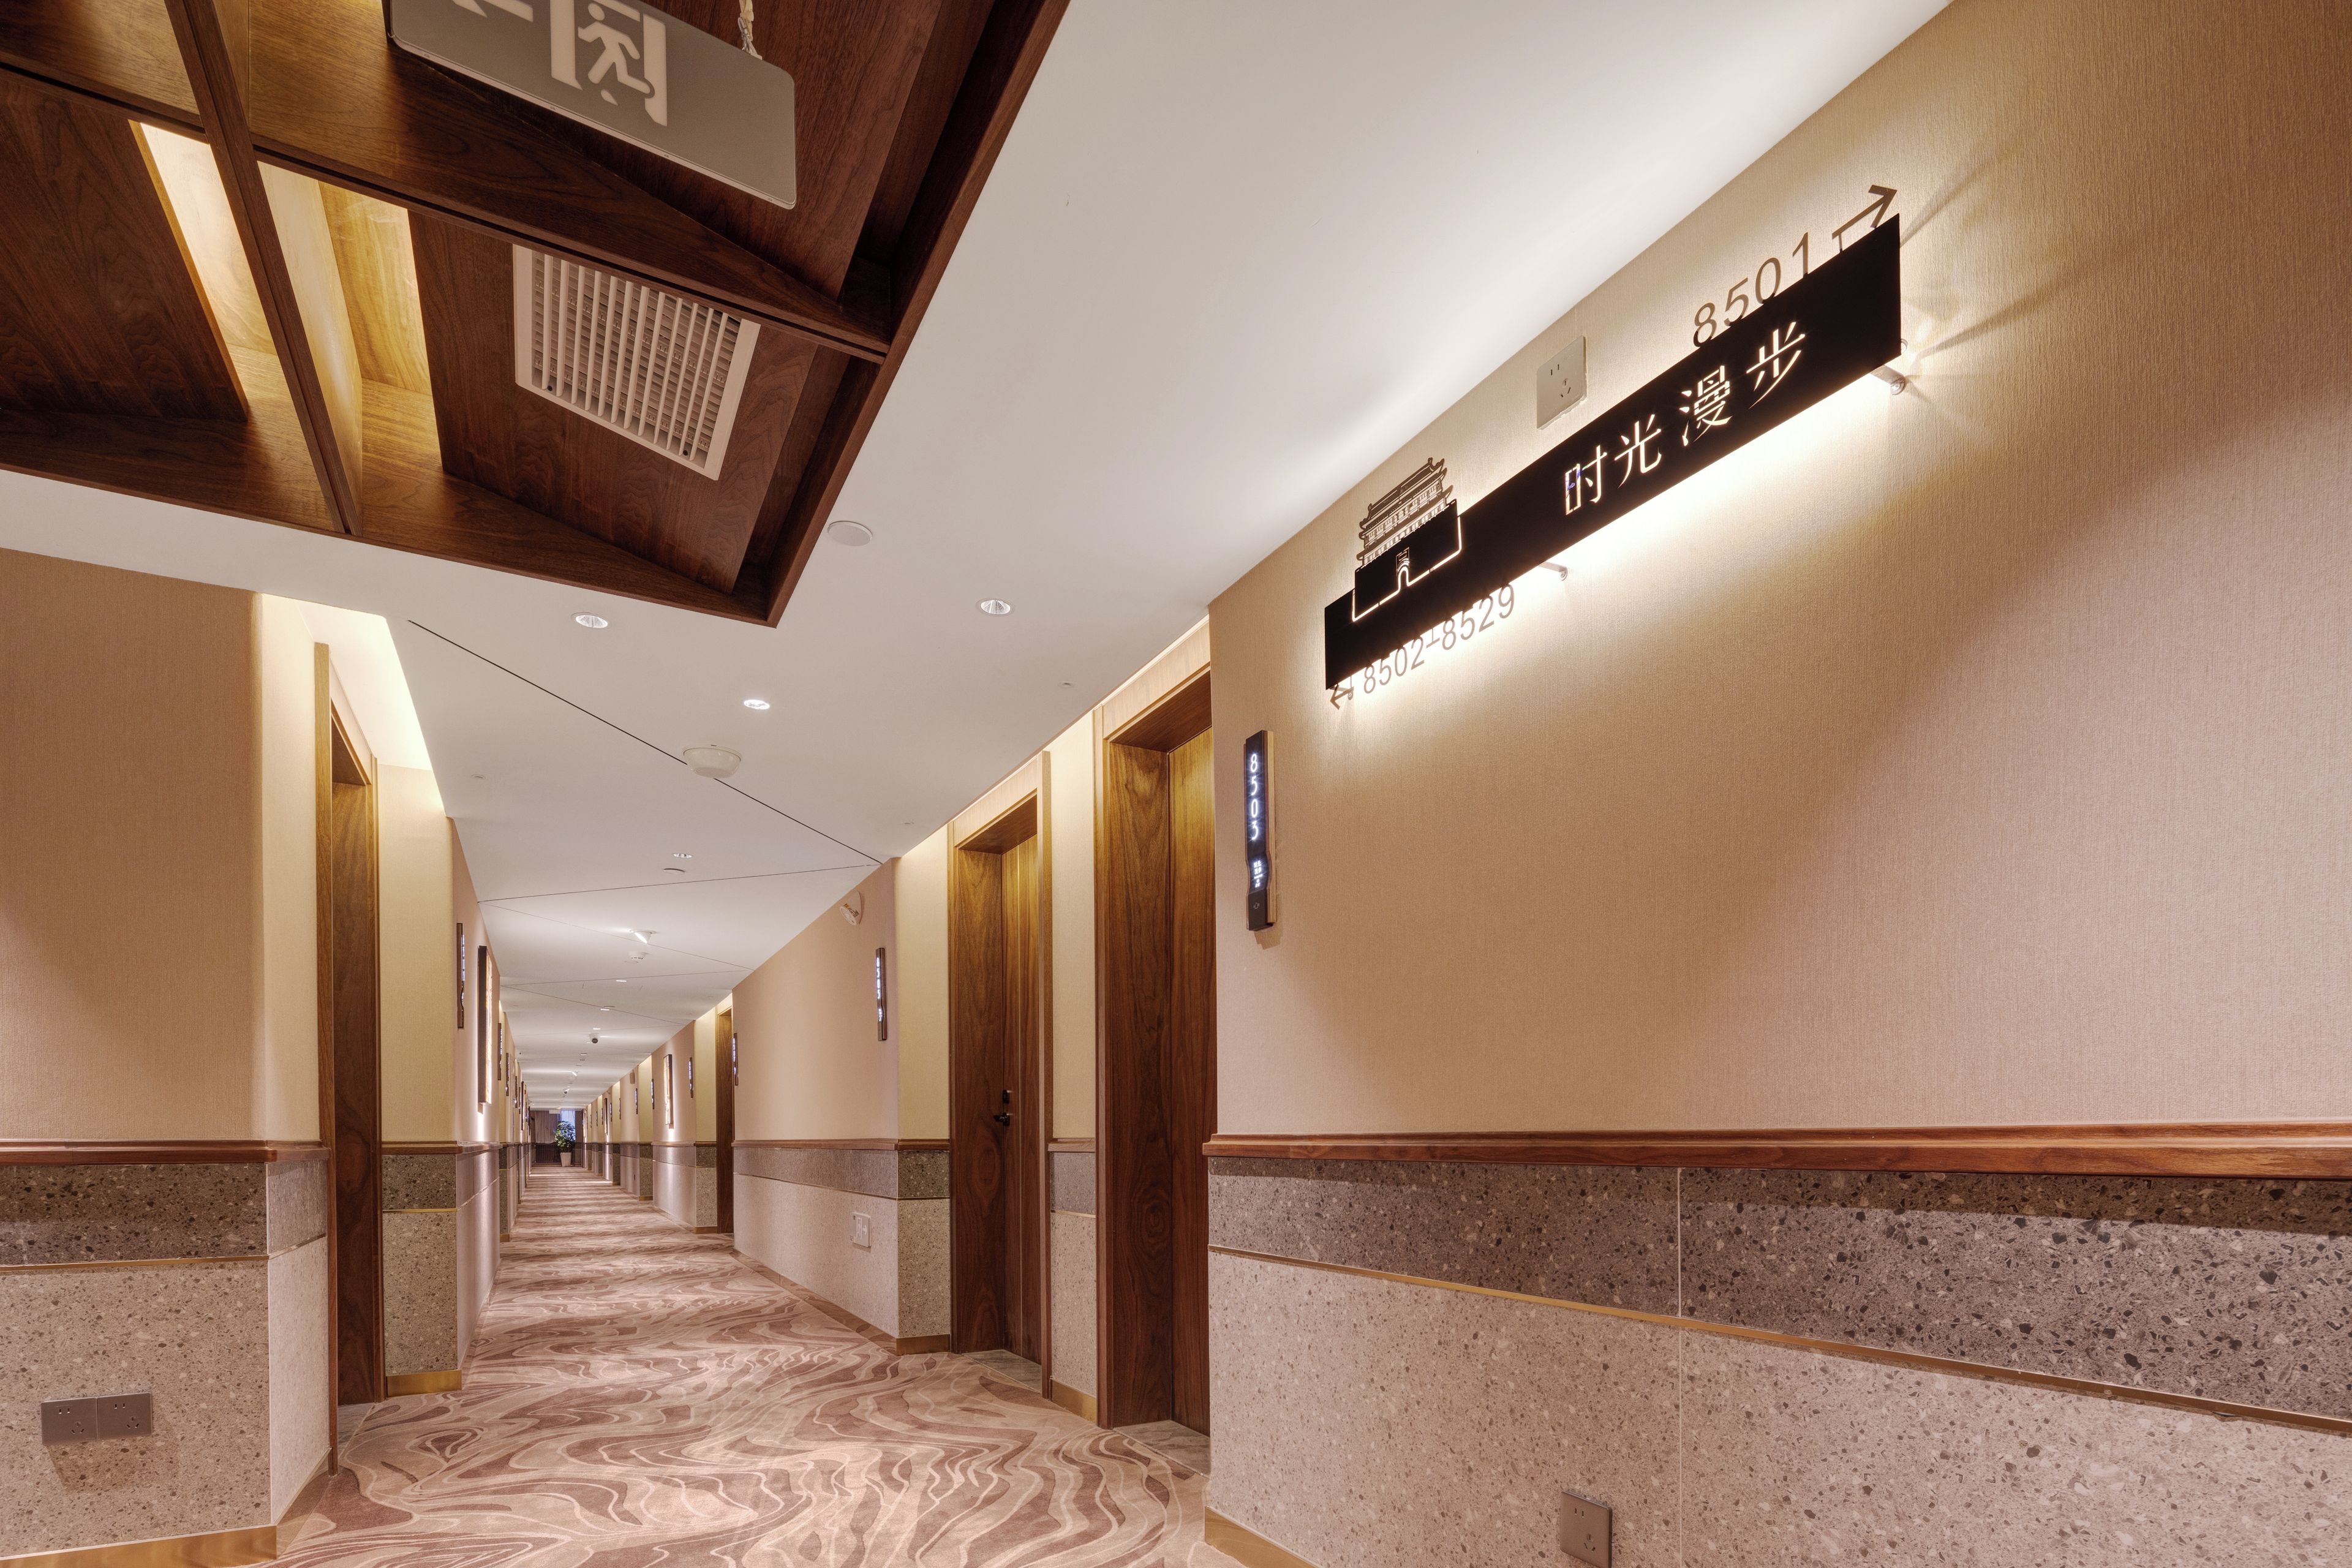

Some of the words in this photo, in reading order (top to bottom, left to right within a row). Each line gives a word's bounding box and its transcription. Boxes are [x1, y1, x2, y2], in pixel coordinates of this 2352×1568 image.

[1693, 232, 1809, 348] 8501
[1564, 321, 1806, 516] 时光漫步
[1363, 584, 1515, 694] 8502-8529
[1250, 753, 1259, 840] 8503
